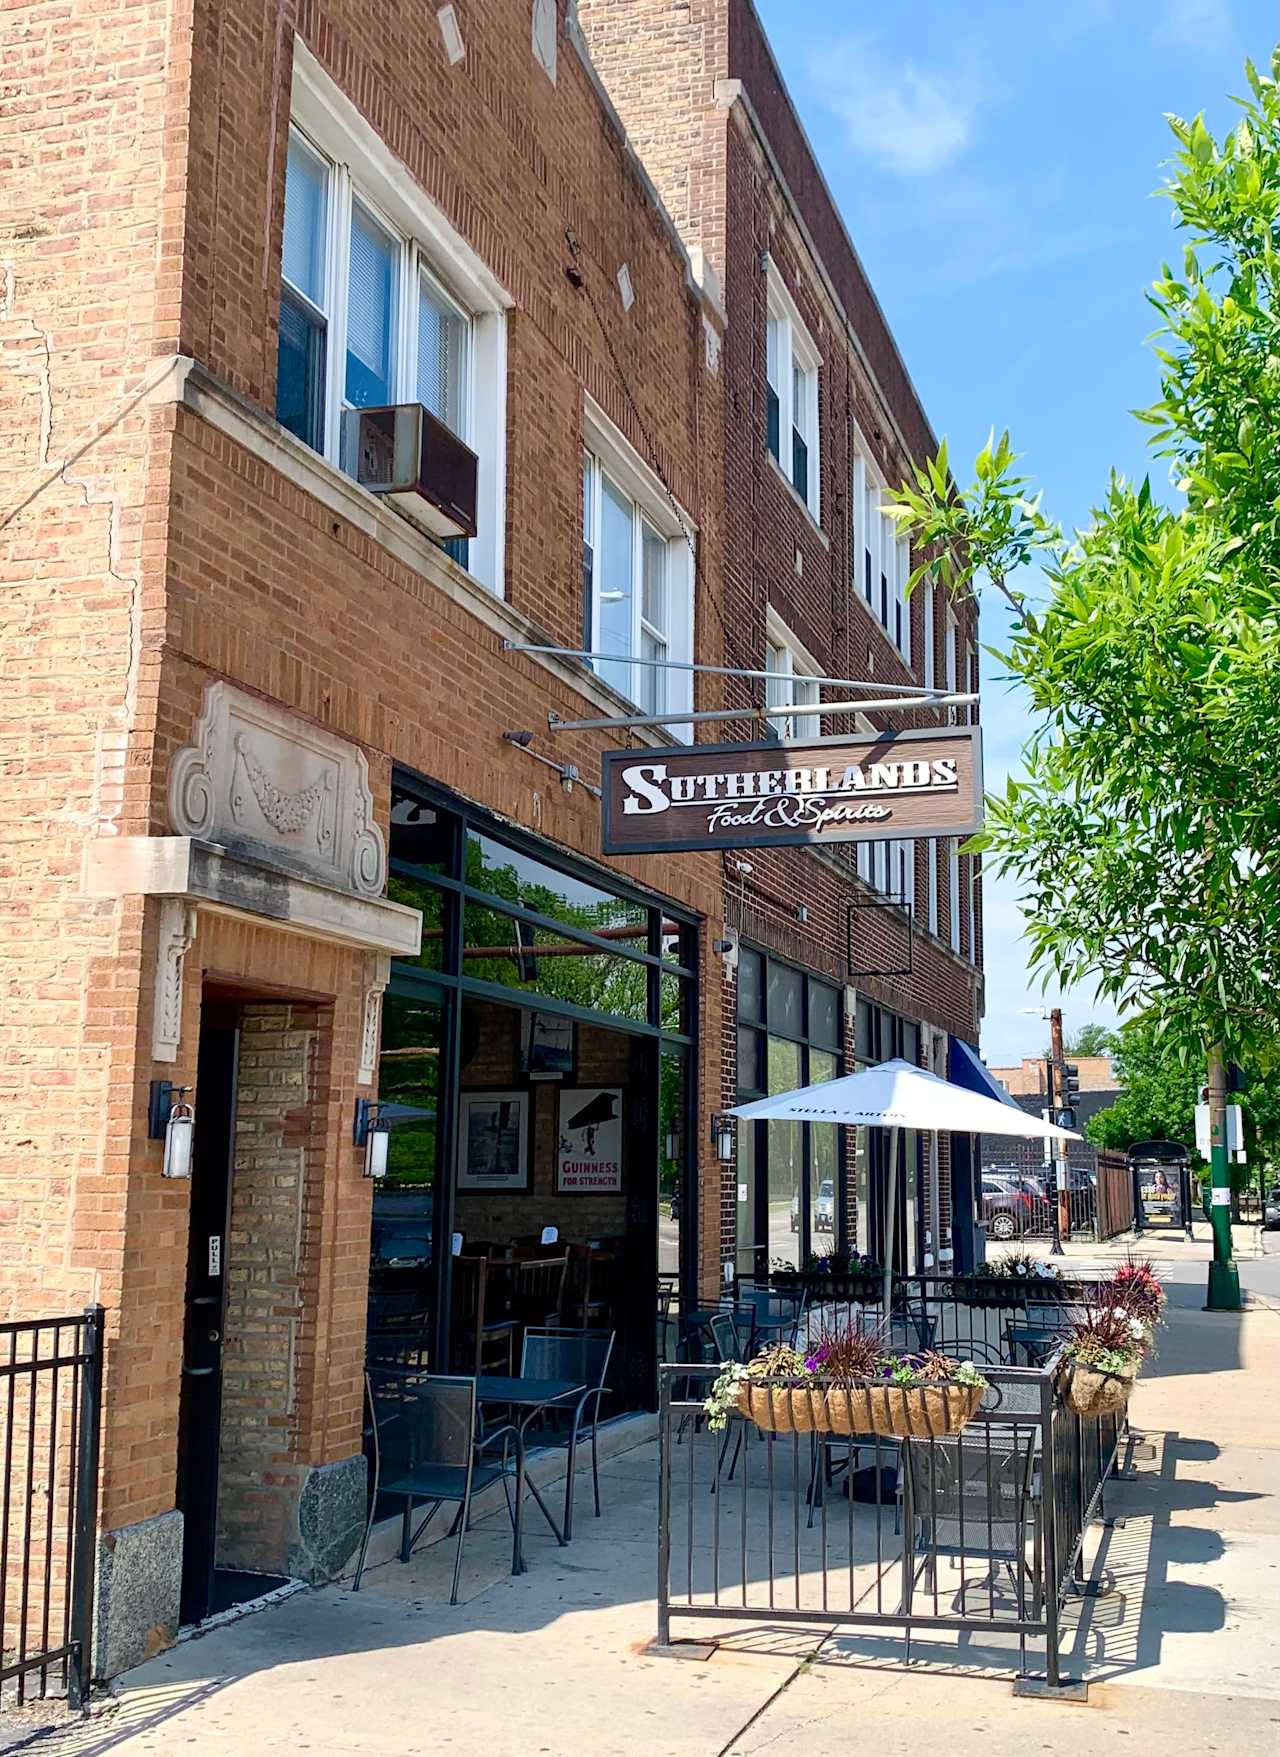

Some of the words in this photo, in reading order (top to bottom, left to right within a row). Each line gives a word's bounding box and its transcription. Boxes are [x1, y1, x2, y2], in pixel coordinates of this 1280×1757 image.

[621, 758, 958, 815] SUTHERLANDS
[707, 802, 764, 832] Food
[796, 798, 891, 831] Spirits
[790, 1106, 837, 1114] STELLA
[562, 1160, 618, 1173] GUINNESS
[563, 1176, 578, 1186] FOR
[579, 1176, 617, 1186] STRENGTH
